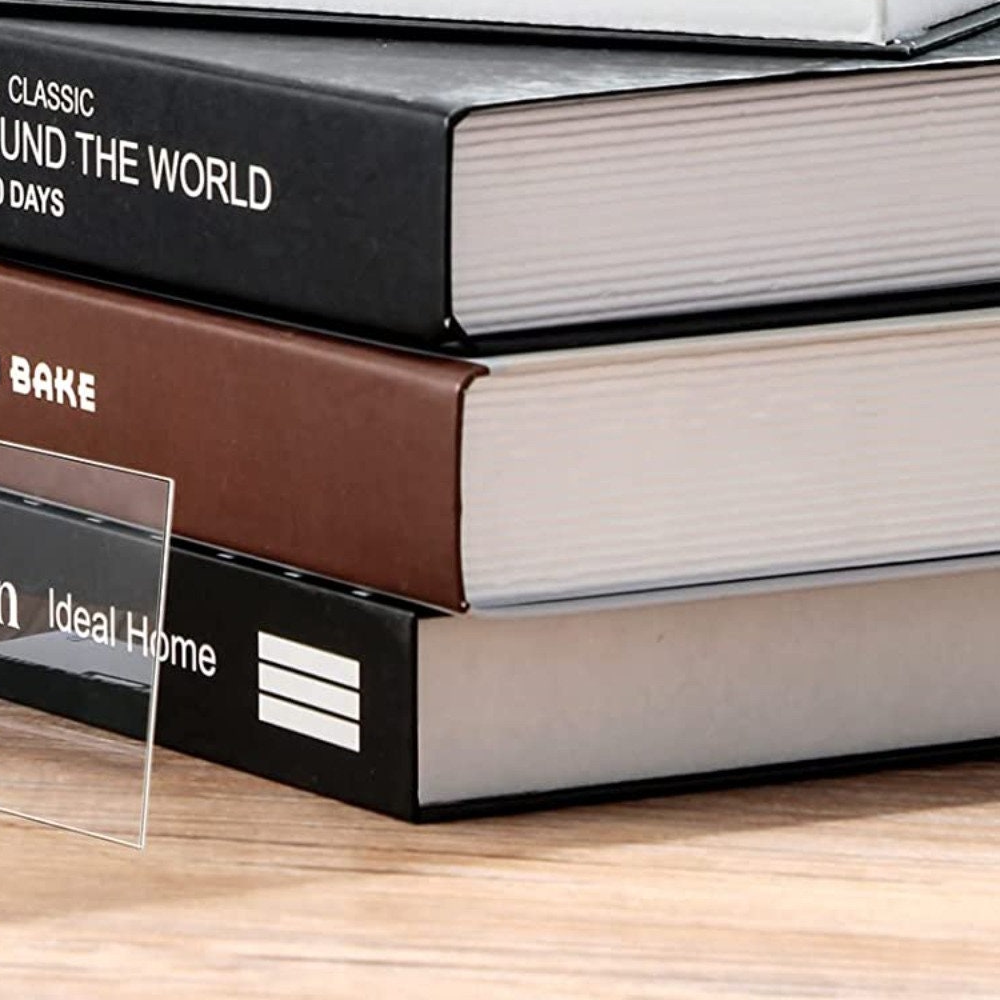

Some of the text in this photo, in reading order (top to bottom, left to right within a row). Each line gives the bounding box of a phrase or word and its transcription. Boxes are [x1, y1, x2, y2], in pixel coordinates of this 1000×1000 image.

[8, 75, 95, 117] CLASSIC
[10, 179, 65, 217] DAYS
[75, 131, 139, 185] THE
[148, 145, 272, 211] WORLD
[9, 355, 96, 412] BAKE
[49, 587, 217, 677] Ideal Home
